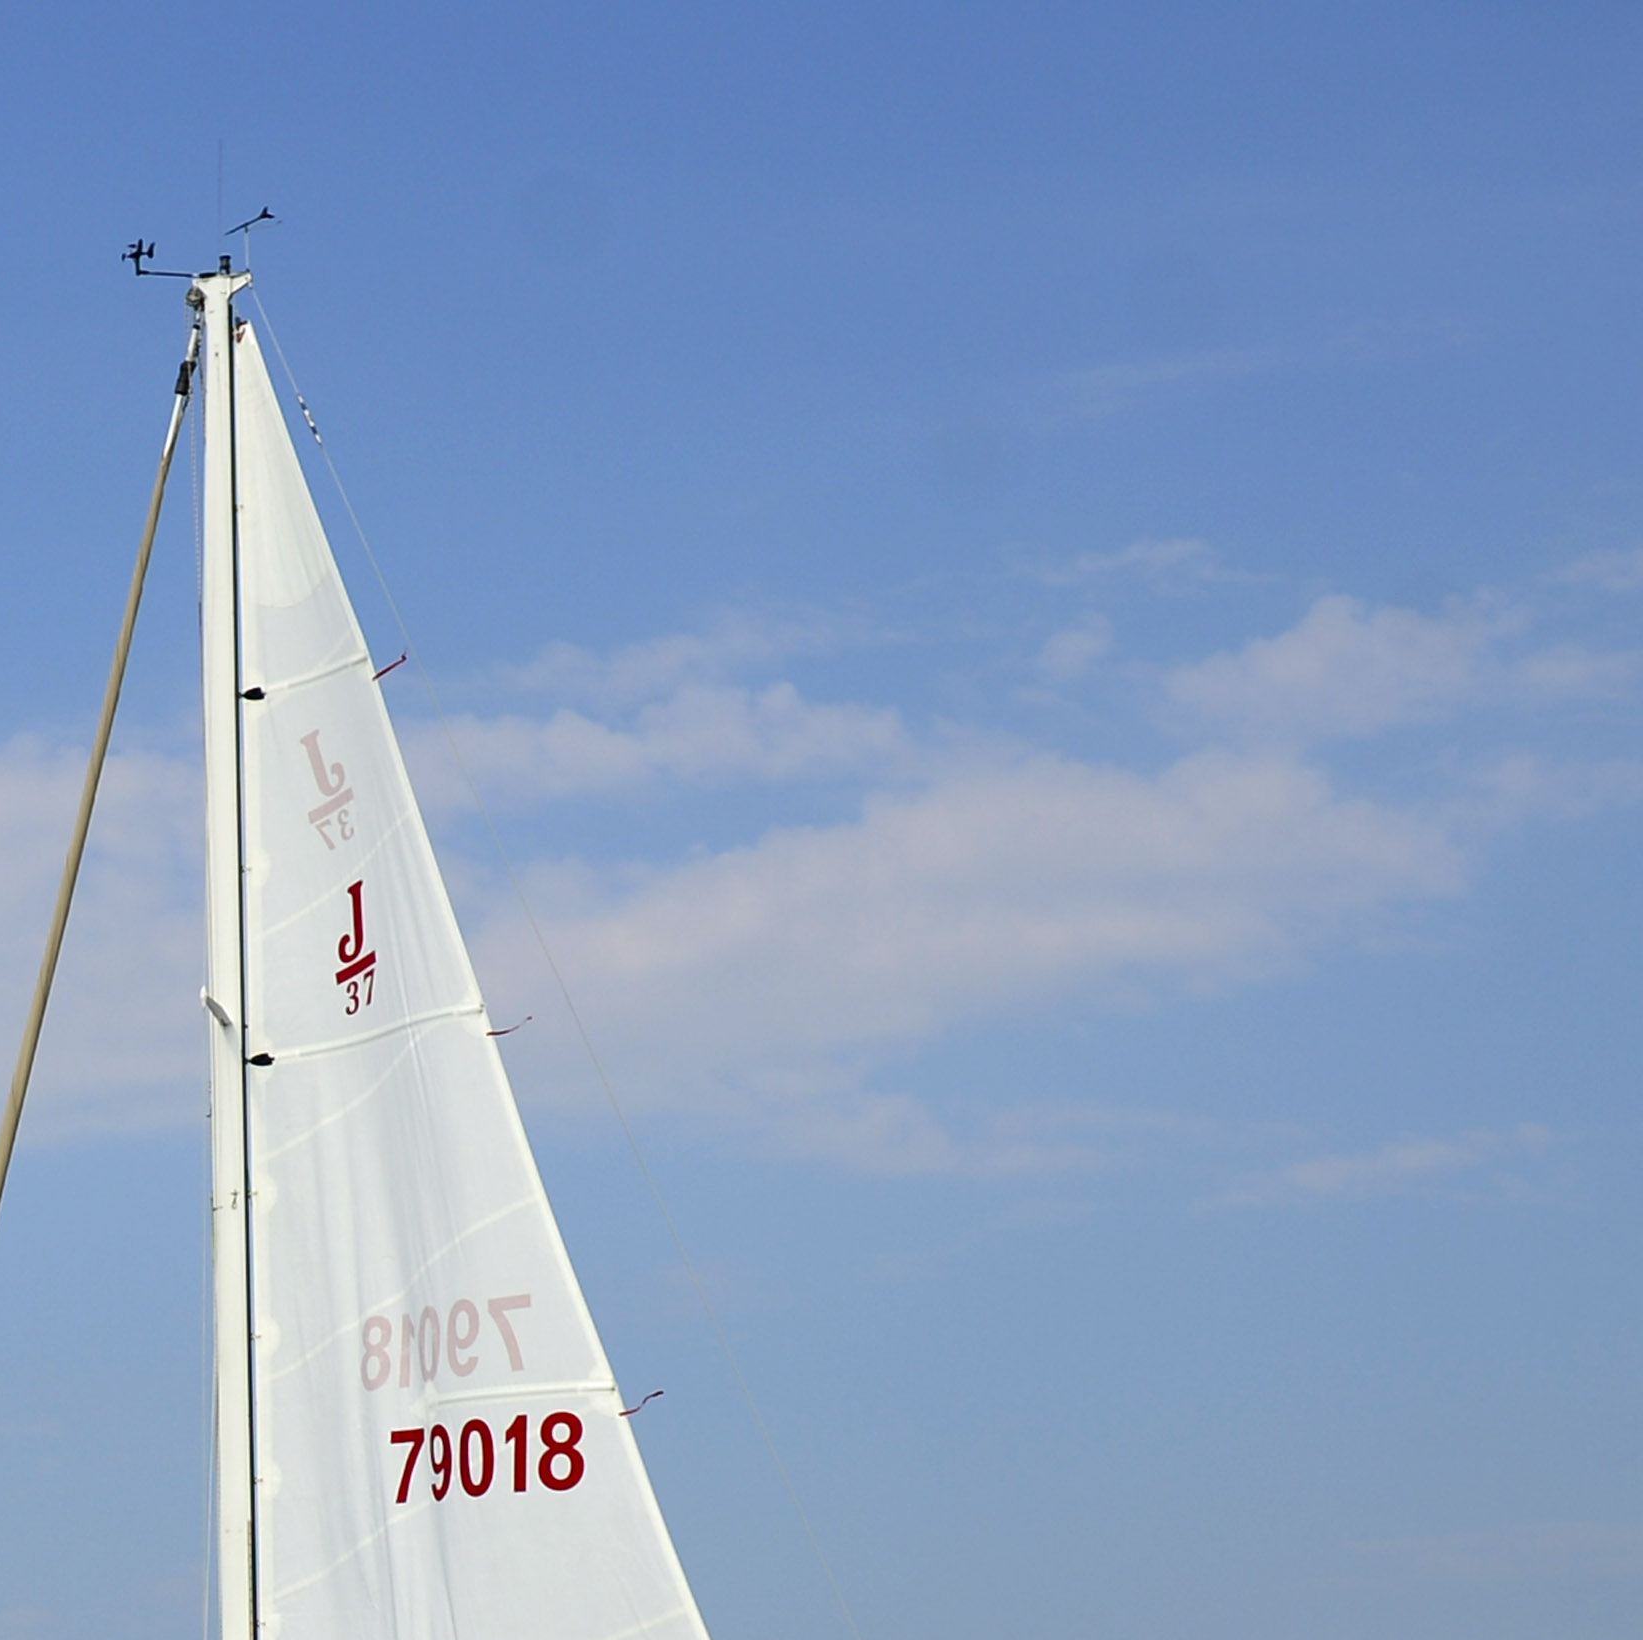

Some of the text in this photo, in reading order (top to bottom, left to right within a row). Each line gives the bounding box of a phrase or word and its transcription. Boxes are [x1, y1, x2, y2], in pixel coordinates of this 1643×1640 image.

[337, 879, 364, 964] J
[345, 968, 375, 1016] 37
[390, 1411, 585, 1504] 79018
